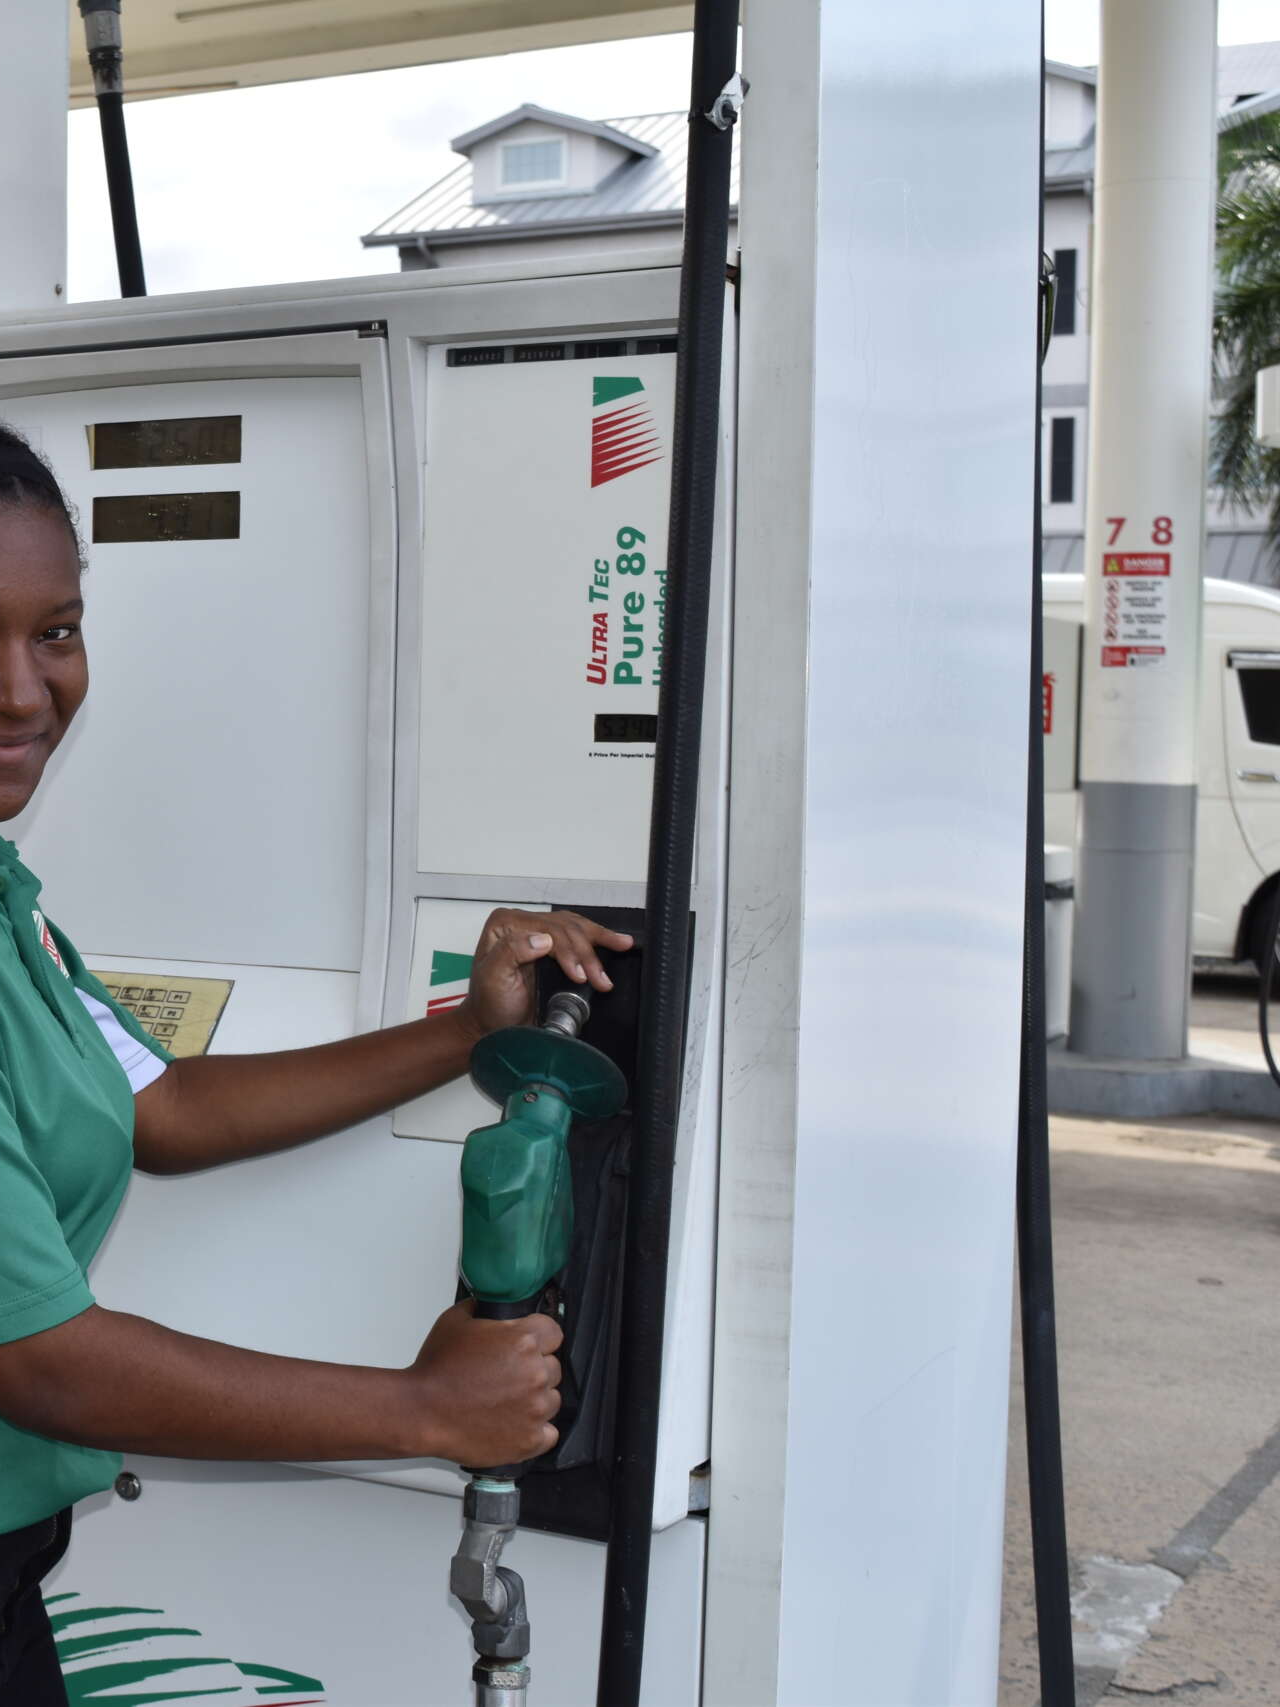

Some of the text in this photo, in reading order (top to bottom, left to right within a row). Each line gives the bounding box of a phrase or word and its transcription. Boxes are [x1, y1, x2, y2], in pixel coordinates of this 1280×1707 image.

[616, 526, 646, 575] 89
[1106, 516, 1173, 546] 7 8
[586, 559, 610, 685] ULTRA TEC
[613, 591, 645, 685] Pure
